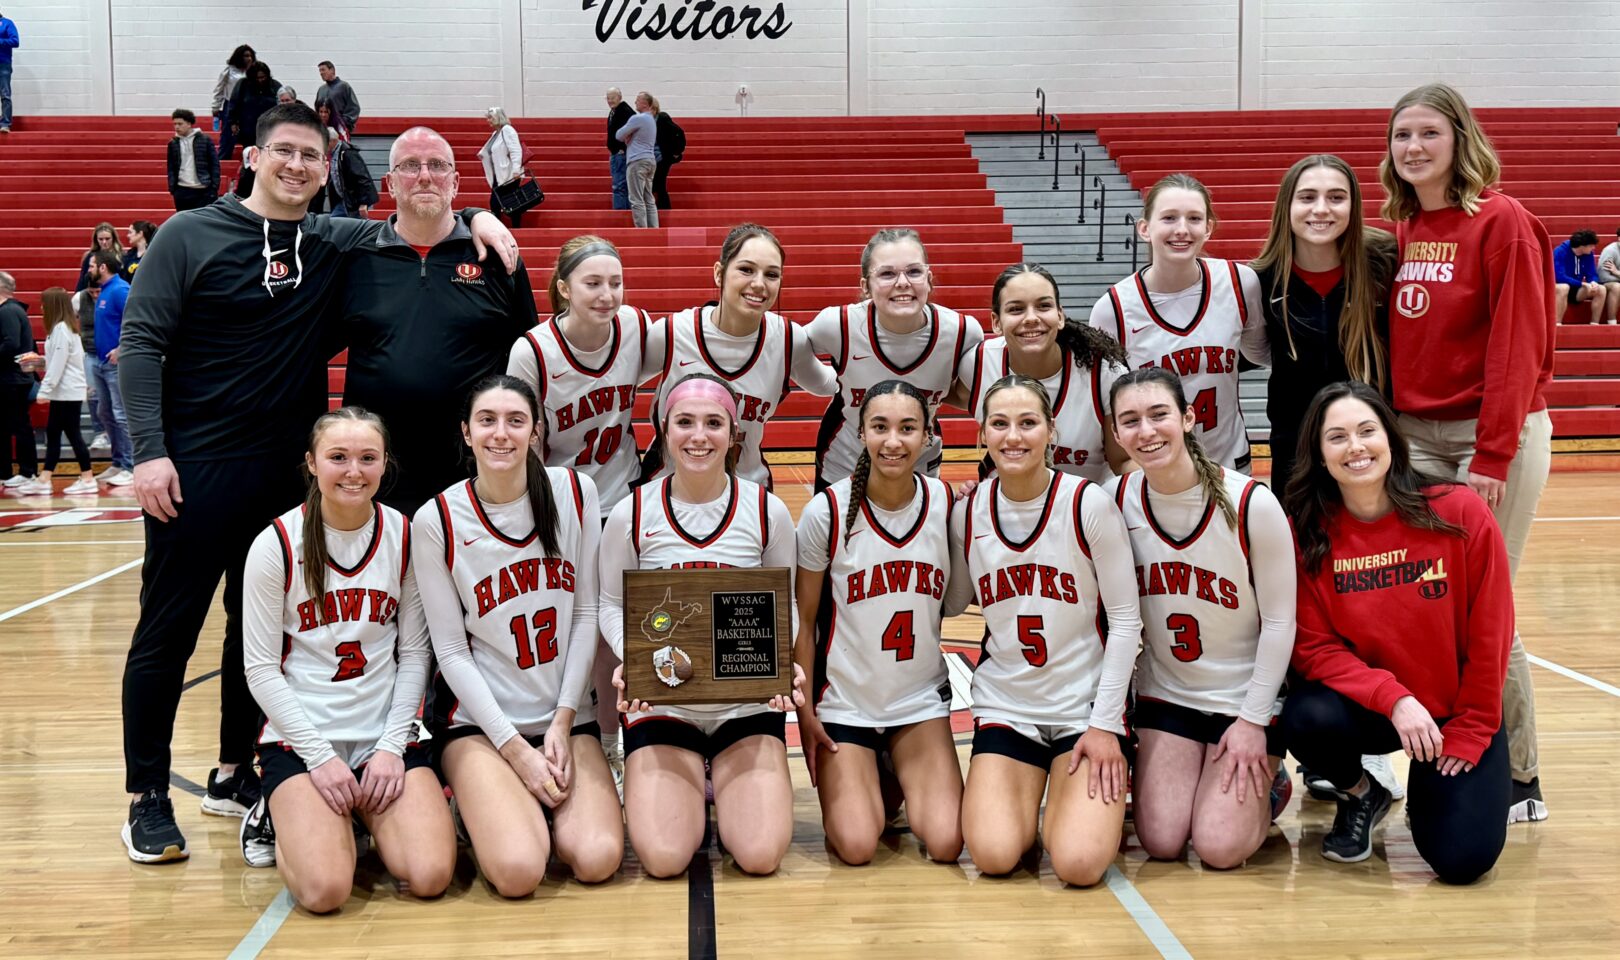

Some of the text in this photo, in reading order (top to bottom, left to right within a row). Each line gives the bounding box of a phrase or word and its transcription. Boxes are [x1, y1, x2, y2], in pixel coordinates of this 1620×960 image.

[582, 0, 793, 43] Visitors
[1395, 262, 1454, 283] AWKS
[575, 423, 622, 466] 10
[1333, 548, 1408, 572] UNIVERSITY
[1334, 557, 1447, 594] BASKETBALL
[474, 557, 575, 619] HAWKS
[721, 596, 766, 605] WVSSAC
[847, 560, 945, 605] HAWKS
[978, 563, 1079, 609] HAWKS
[1135, 561, 1239, 610] HAWKS
[297, 588, 397, 632] HAWKS
[734, 607, 754, 616] 2025
[510, 606, 558, 670] 12
[717, 628, 772, 639] BASKETBALL
[881, 610, 915, 662] 4
[1017, 615, 1048, 667] 5
[1166, 613, 1203, 662] 3
[331, 640, 368, 682] 2
[720, 663, 771, 673] CHAMPION
[722, 653, 769, 663] REGIONAL
